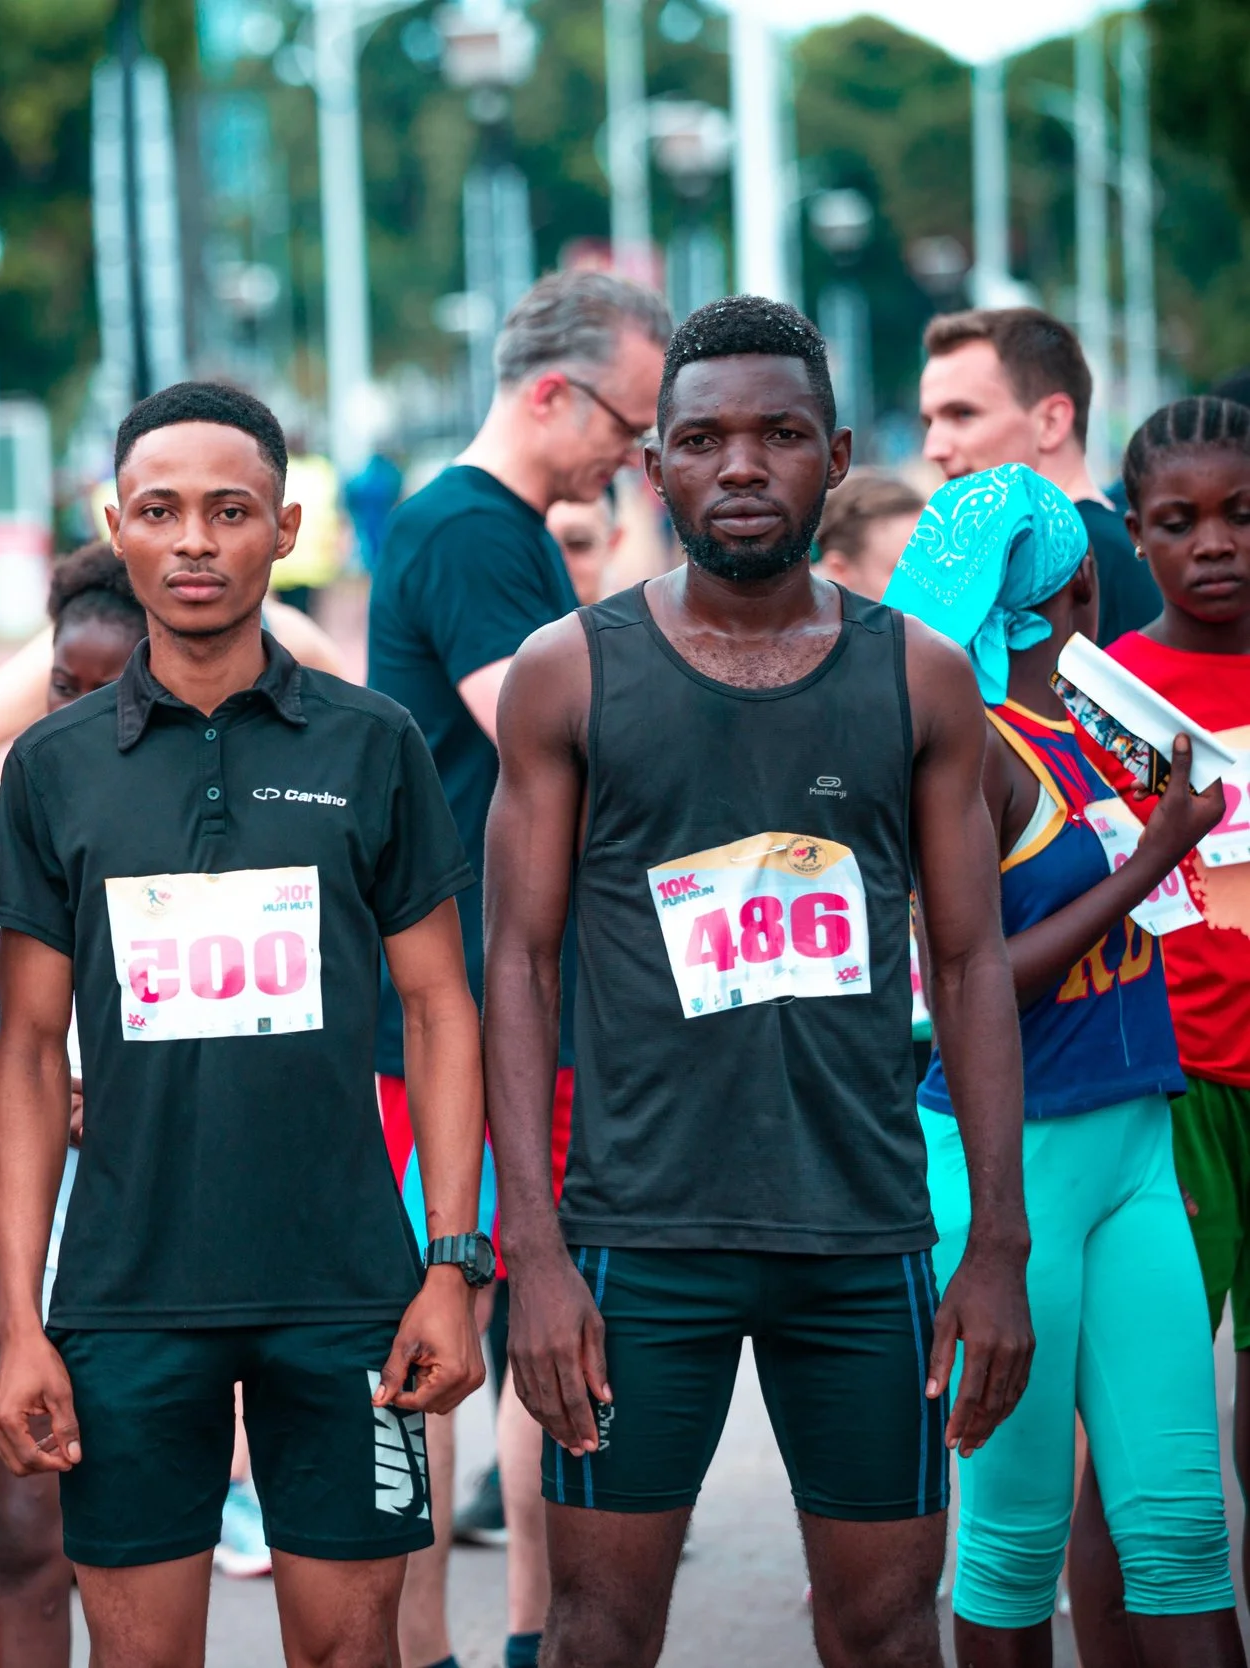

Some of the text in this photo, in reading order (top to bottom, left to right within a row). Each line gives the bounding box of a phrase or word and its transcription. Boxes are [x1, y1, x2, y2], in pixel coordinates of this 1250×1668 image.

[284, 789, 347, 807] Cardno
[657, 873, 701, 899] 10K
[661, 885, 715, 909] FUN RUN
[685, 892, 851, 973] 486
